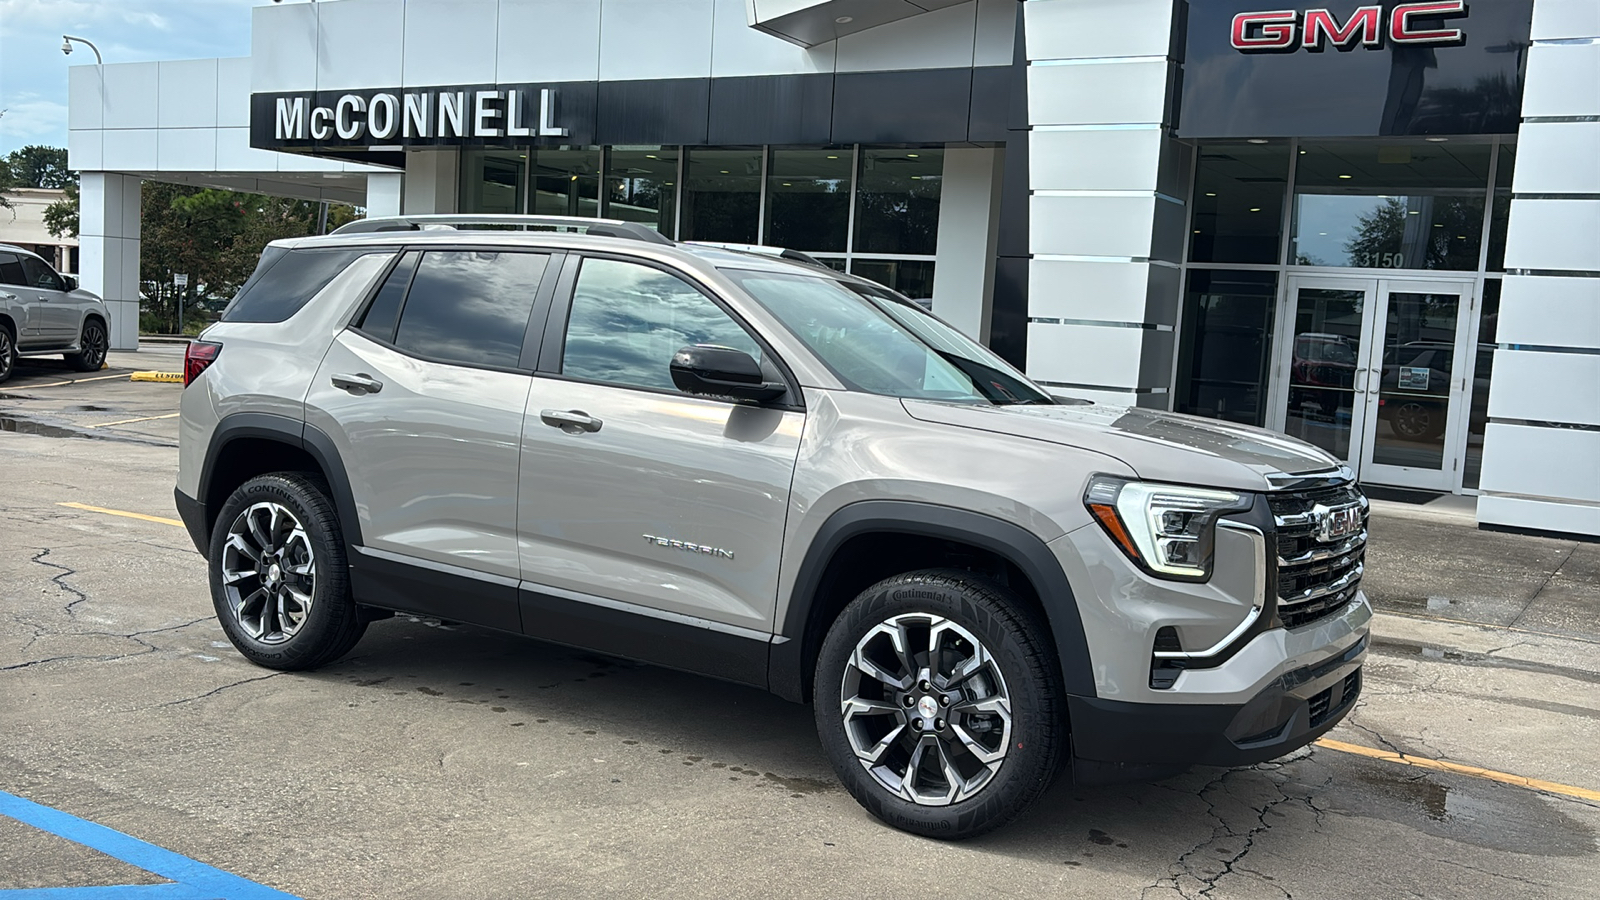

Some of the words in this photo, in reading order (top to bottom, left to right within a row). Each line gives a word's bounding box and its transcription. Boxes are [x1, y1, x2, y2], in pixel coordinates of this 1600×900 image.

[1230, 0, 1465, 50] GMC
[275, 89, 567, 140] McCONNELL
[1361, 252, 1404, 268] 3150
[642, 534, 734, 559] TERRAIN
[892, 588, 947, 603] Continental
